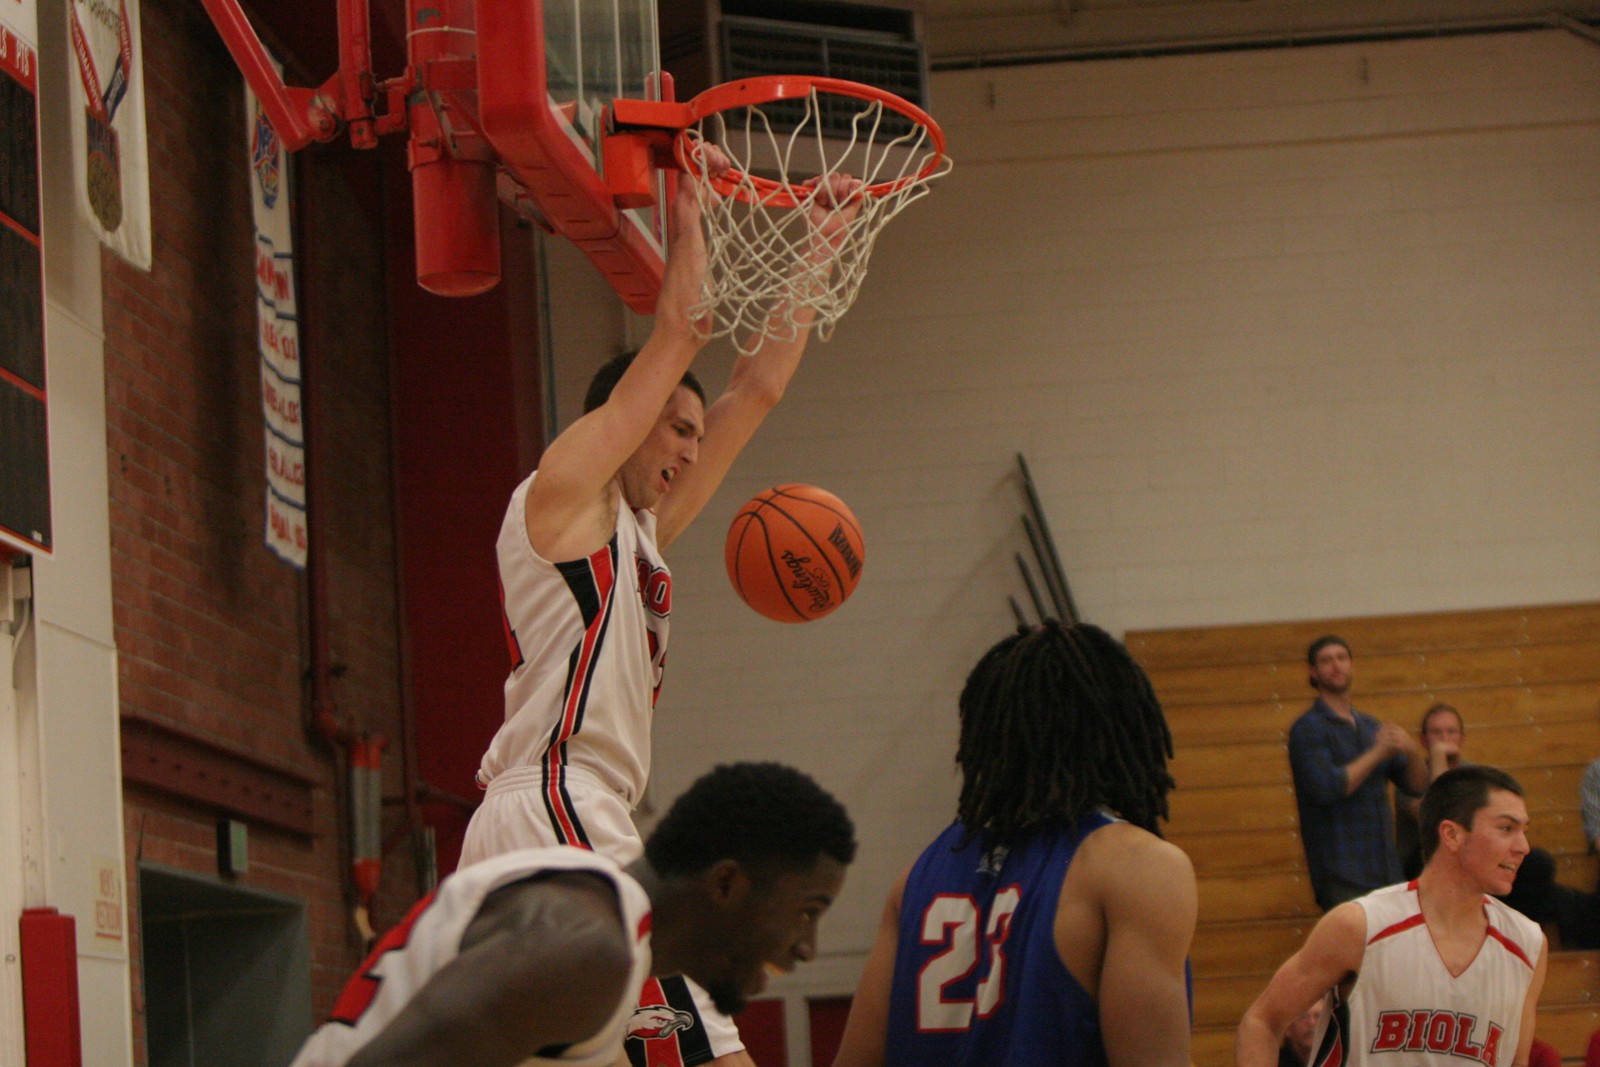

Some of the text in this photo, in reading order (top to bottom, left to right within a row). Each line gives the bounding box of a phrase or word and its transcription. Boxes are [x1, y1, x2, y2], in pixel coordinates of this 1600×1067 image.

[16, 38, 30, 77] PTS
[781, 550, 835, 613] Rawlings
[916, 882, 1024, 1034] 23
[1370, 1009, 1504, 1067] BIOLA
